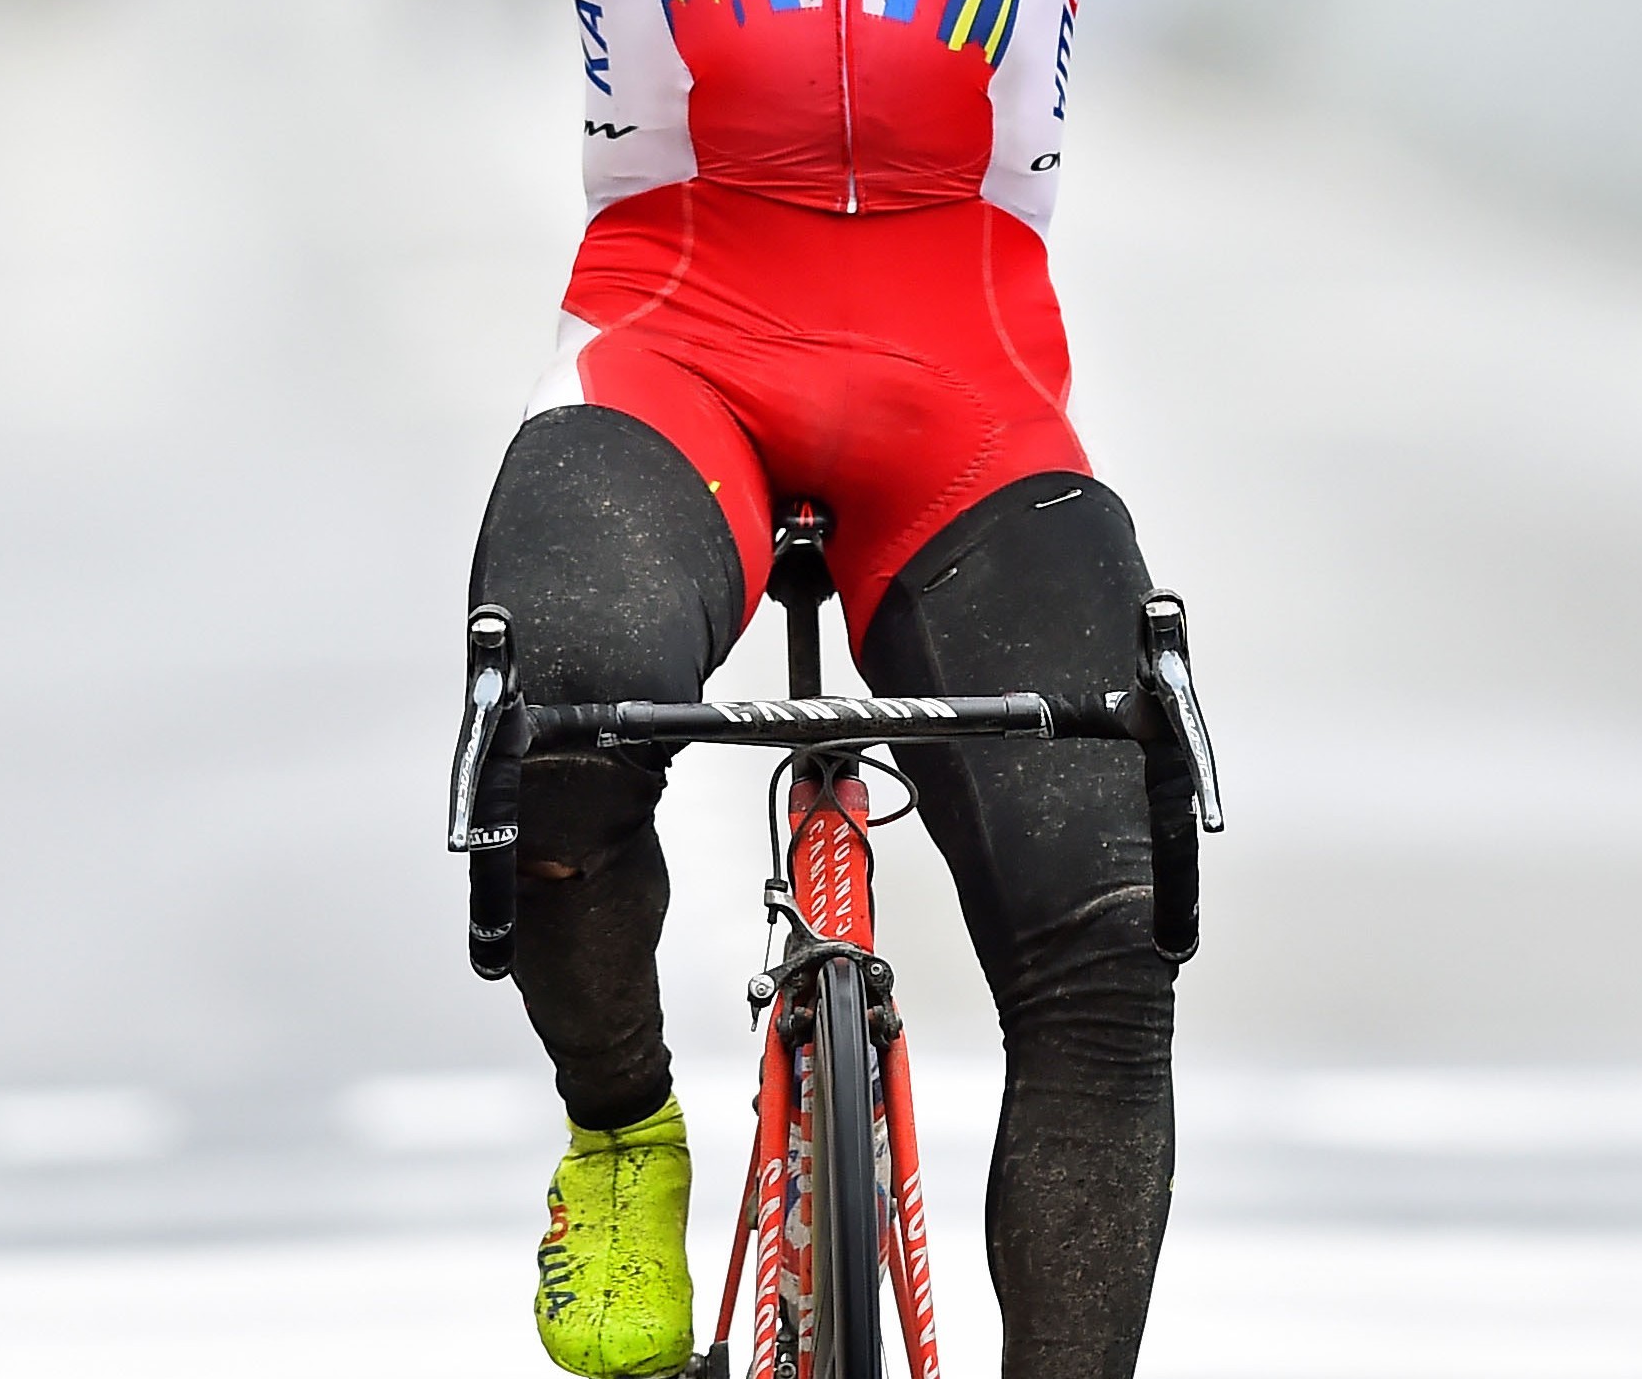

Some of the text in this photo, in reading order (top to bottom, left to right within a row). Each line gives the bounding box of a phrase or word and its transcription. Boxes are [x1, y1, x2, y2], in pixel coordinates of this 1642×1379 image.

[584, 119, 639, 140] W
[1030, 151, 1061, 172] O
[712, 697, 958, 723] CANYON
[809, 819, 828, 934] CANYON
[833, 822, 853, 937] CANYON
